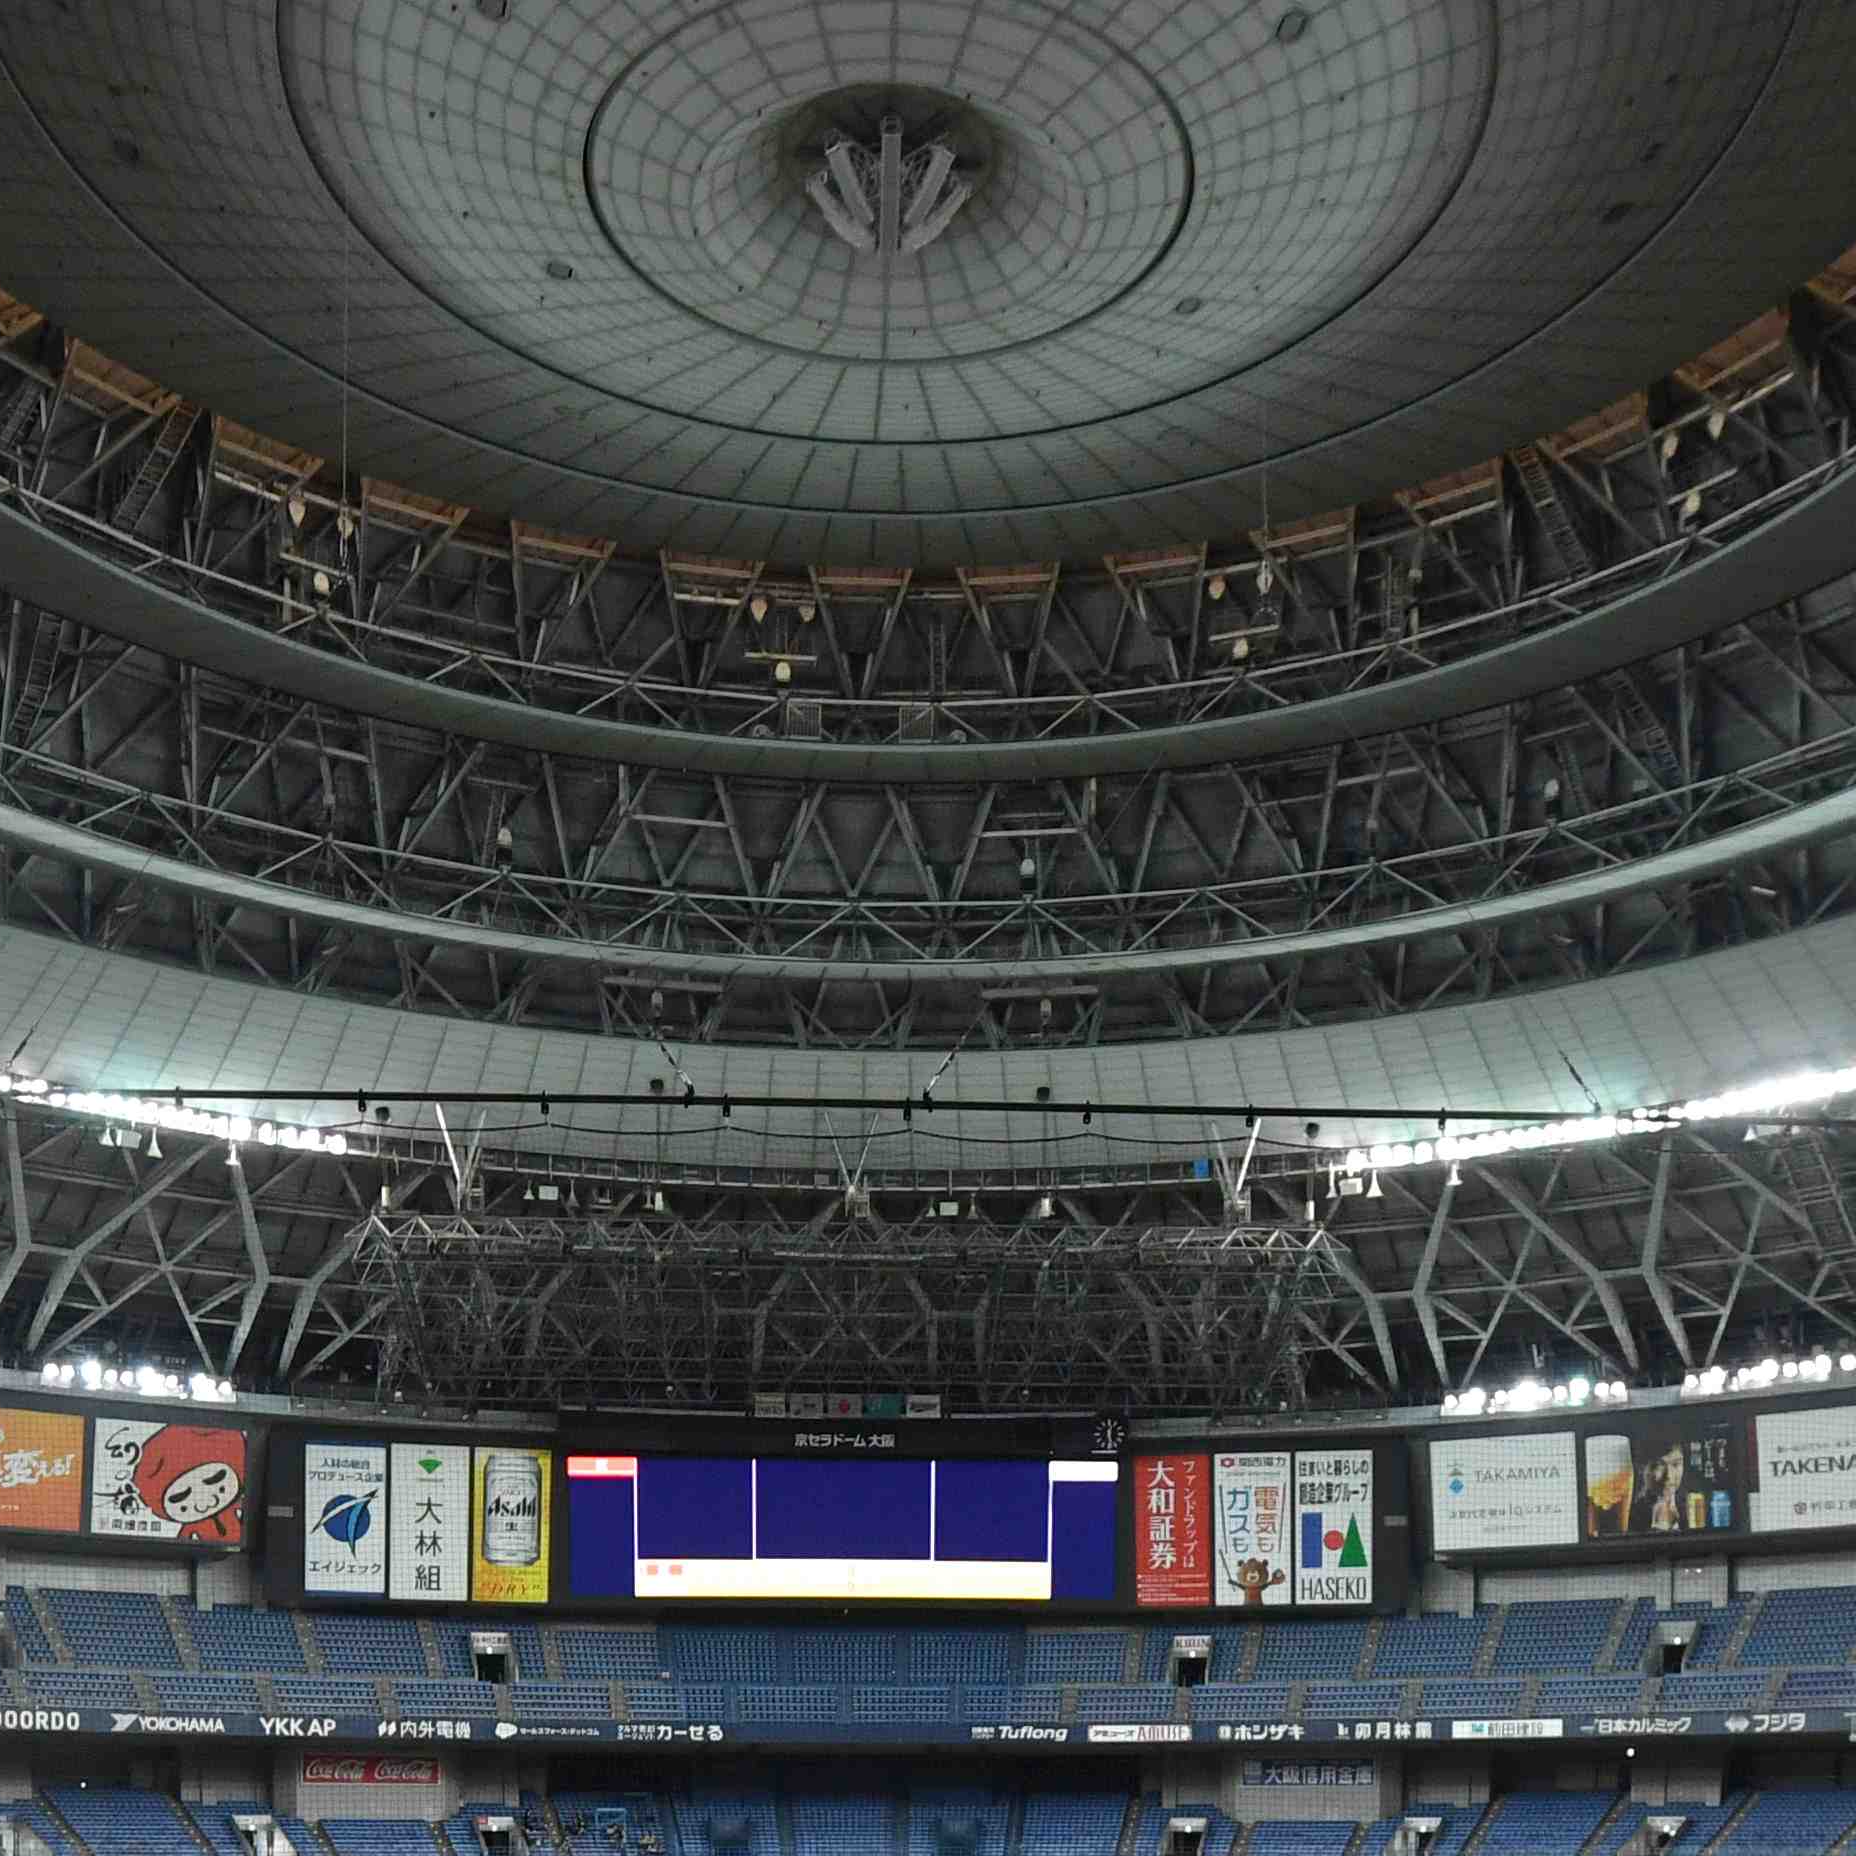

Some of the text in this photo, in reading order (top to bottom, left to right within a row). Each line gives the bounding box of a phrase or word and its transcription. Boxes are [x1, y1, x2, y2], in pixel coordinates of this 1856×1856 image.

[794, 1433, 895, 1447] 京セラドーム 大阪
[1473, 1464, 1562, 1484] TAKAMIYA
[488, 1496, 536, 1518] Asahi
[1148, 1460, 1176, 1569] 大和証券
[1227, 1486, 1252, 1553] ガスも
[1254, 1486, 1280, 1553] 電気も
[414, 1496, 444, 1592] 大林組
[309, 1560, 382, 1576] エイジェック
[1301, 1576, 1367, 1601] HASEKO
[139, 1716, 225, 1733] YOKOHAMA
[260, 1717, 336, 1736] YKK AP
[1598, 1717, 1692, 1733] 日本カルミック
[1753, 1713, 1806, 1732] フジタ
[657, 1725, 723, 1741] カーせる
[999, 1726, 1068, 1741] Tuflong
[1234, 1724, 1304, 1741] ホシザキ
